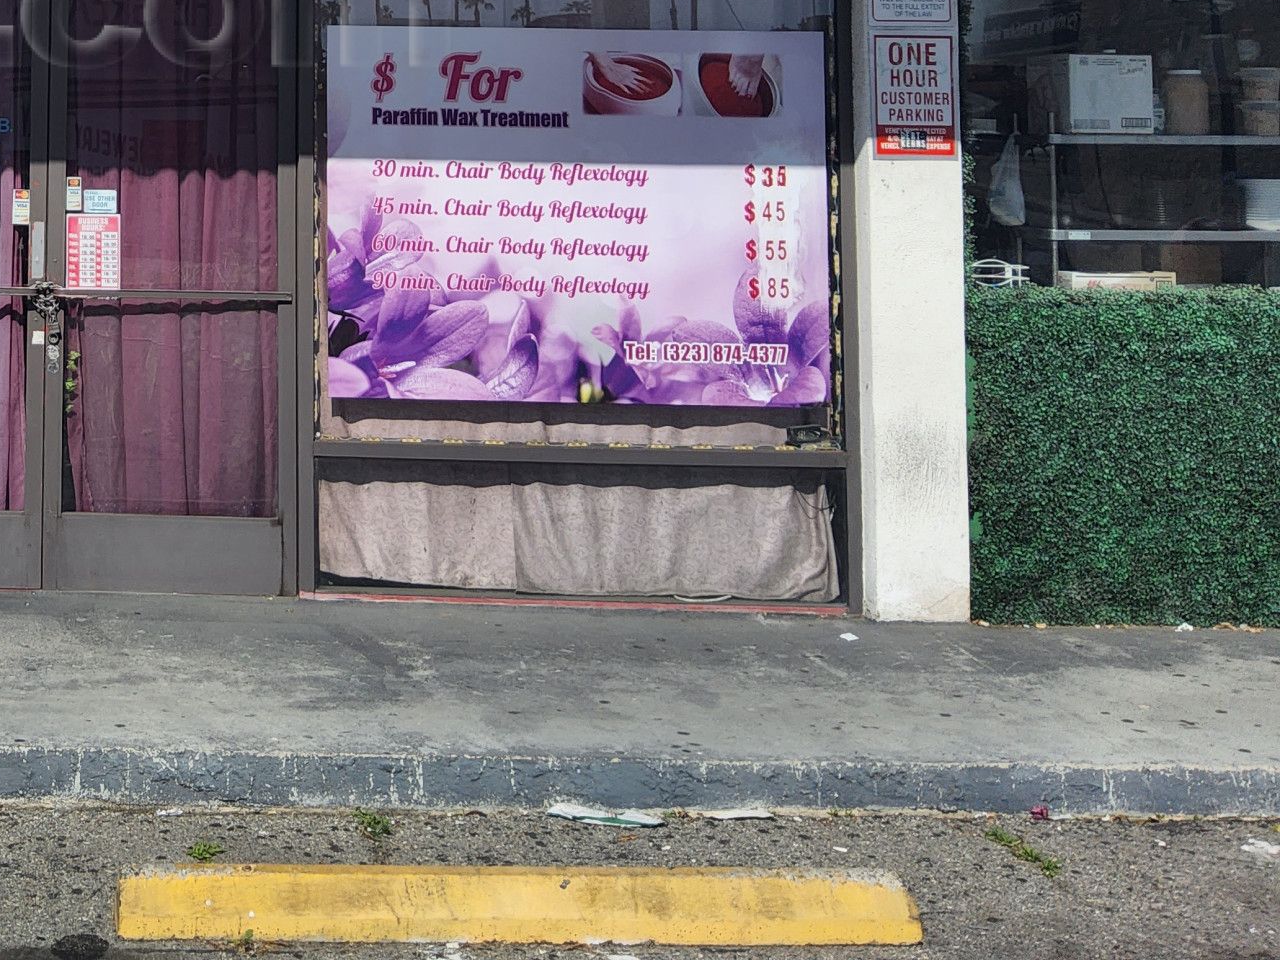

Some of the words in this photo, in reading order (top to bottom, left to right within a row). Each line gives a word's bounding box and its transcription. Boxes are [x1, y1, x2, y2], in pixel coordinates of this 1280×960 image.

[889, 42, 937, 66] ONE
[372, 53, 397, 103] $
[439, 51, 525, 103] For
[890, 69, 937, 87] HOUR
[881, 92, 949, 105] CUSTOMER
[372, 107, 438, 125] Paraffin
[441, 108, 479, 126] Wax
[480, 109, 569, 128] Treatment
[889, 109, 943, 122] PARKING
[373, 159, 396, 177] 30
[400, 161, 439, 178] min.
[446, 161, 493, 178] Chair
[498, 162, 546, 185] Body
[550, 163, 649, 186] Reflexology
[373, 197, 394, 215] 45
[399, 199, 438, 215] min.
[445, 198, 492, 216] Chair
[497, 200, 544, 222] Body
[549, 201, 648, 224] Reflexology
[373, 234, 396, 251] 60
[400, 236, 439, 252] min.
[446, 236, 494, 253] Chair
[499, 237, 546, 259] Body
[551, 238, 649, 262] Reflexology
[373, 272, 396, 289] 90
[401, 273, 440, 290] min.
[446, 273, 495, 291] Chair
[499, 274, 546, 297] Body
[551, 275, 650, 299] Reflexology
[624, 342, 656, 361] Tel:
[663, 344, 708, 361] (323)
[713, 344, 787, 363] 874-4377
